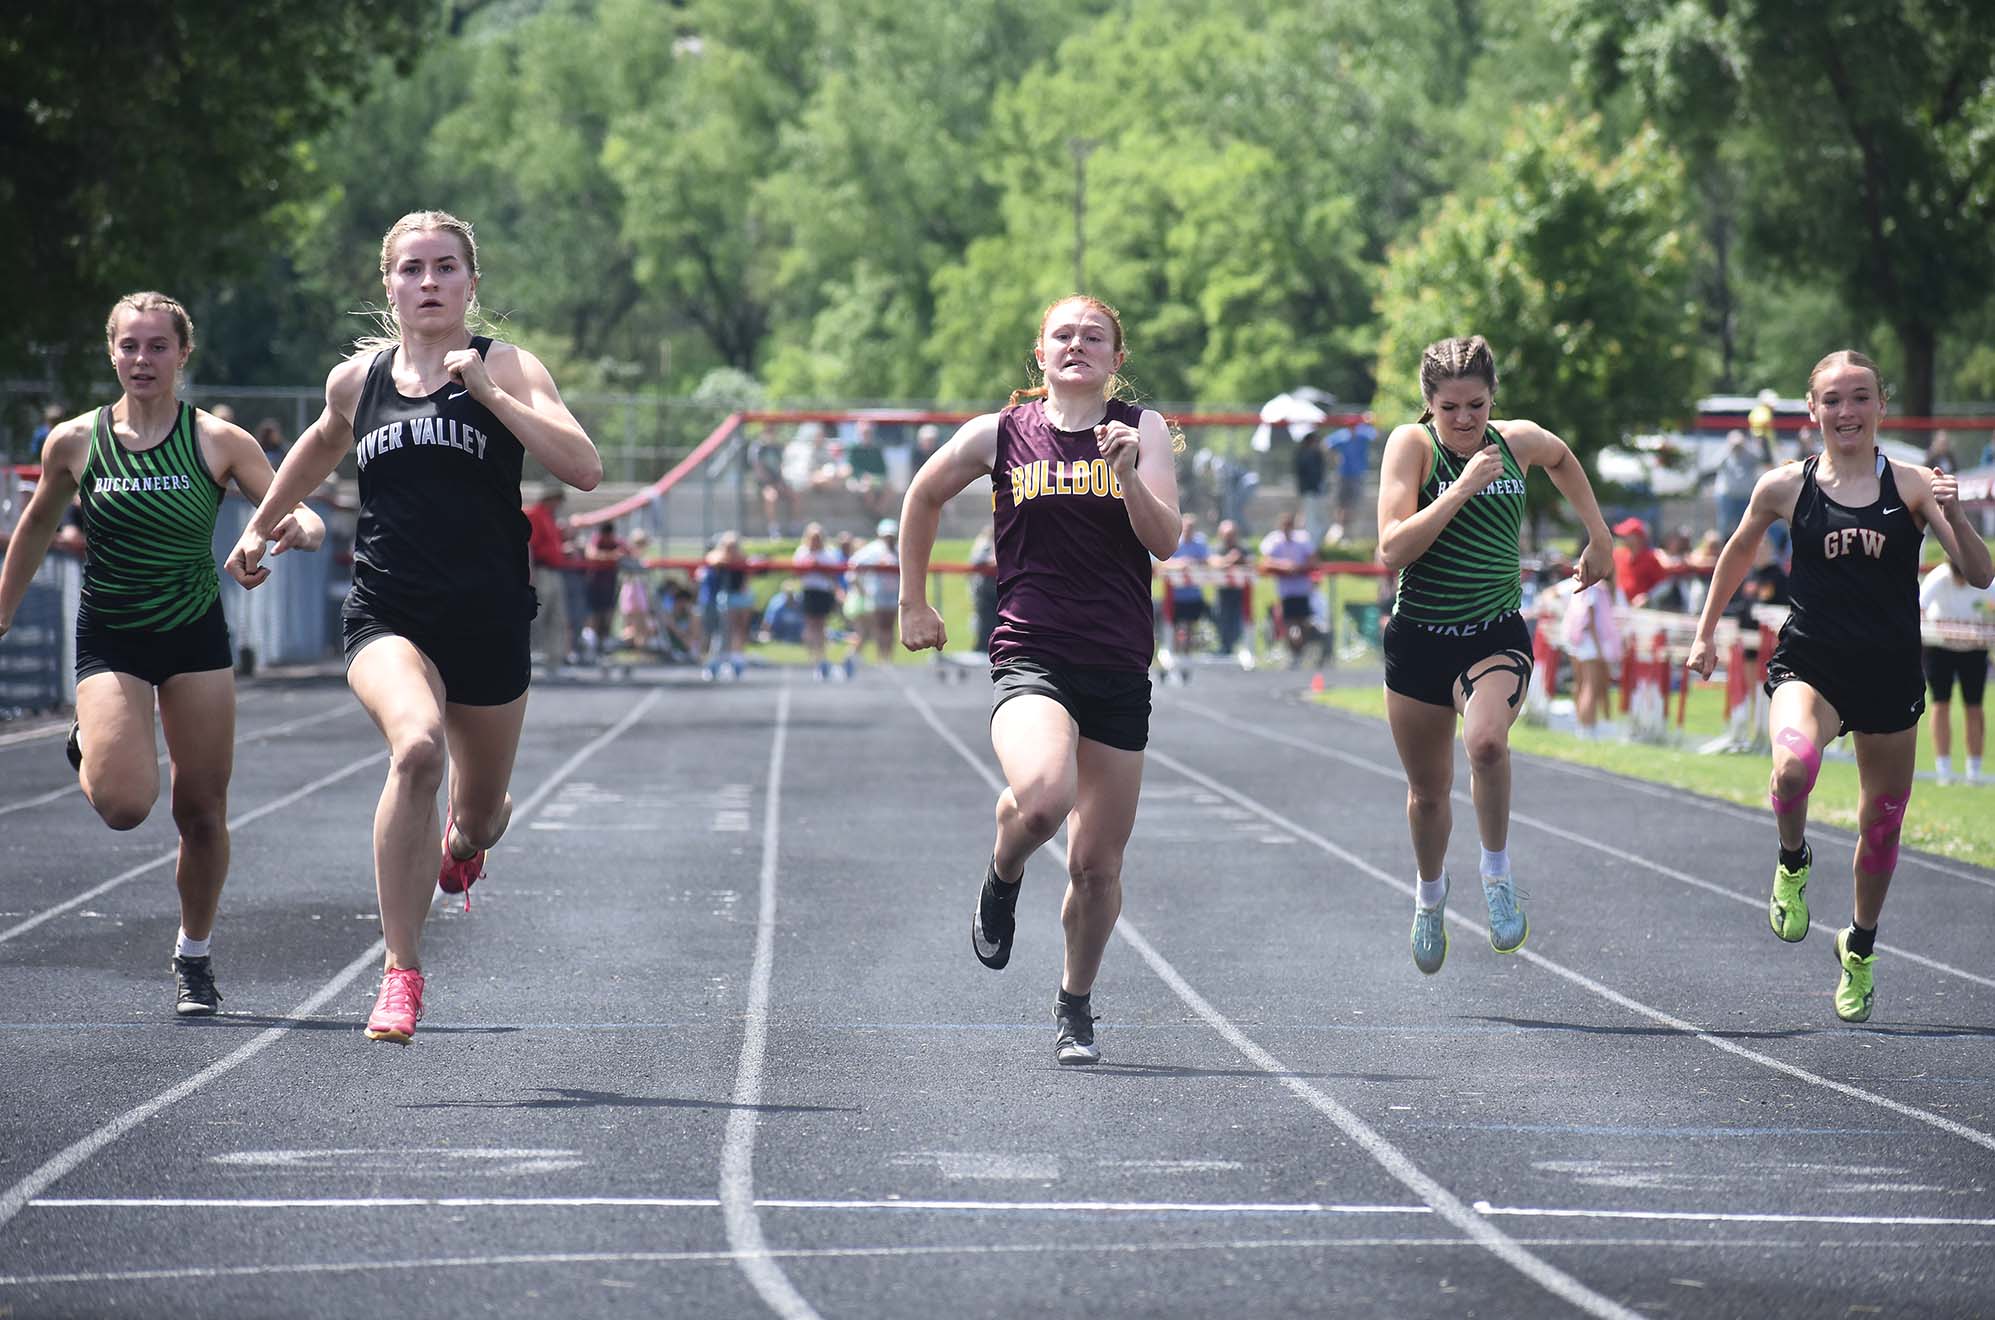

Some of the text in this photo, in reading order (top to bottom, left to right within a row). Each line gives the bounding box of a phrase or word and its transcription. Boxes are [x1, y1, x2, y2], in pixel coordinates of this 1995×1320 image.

[356, 417, 487, 472] RIVER VALLEY
[94, 474, 190, 493] BUCCANEERS
[1437, 479, 1525, 496] BNEERS
[1824, 528, 1886, 560] GFW
